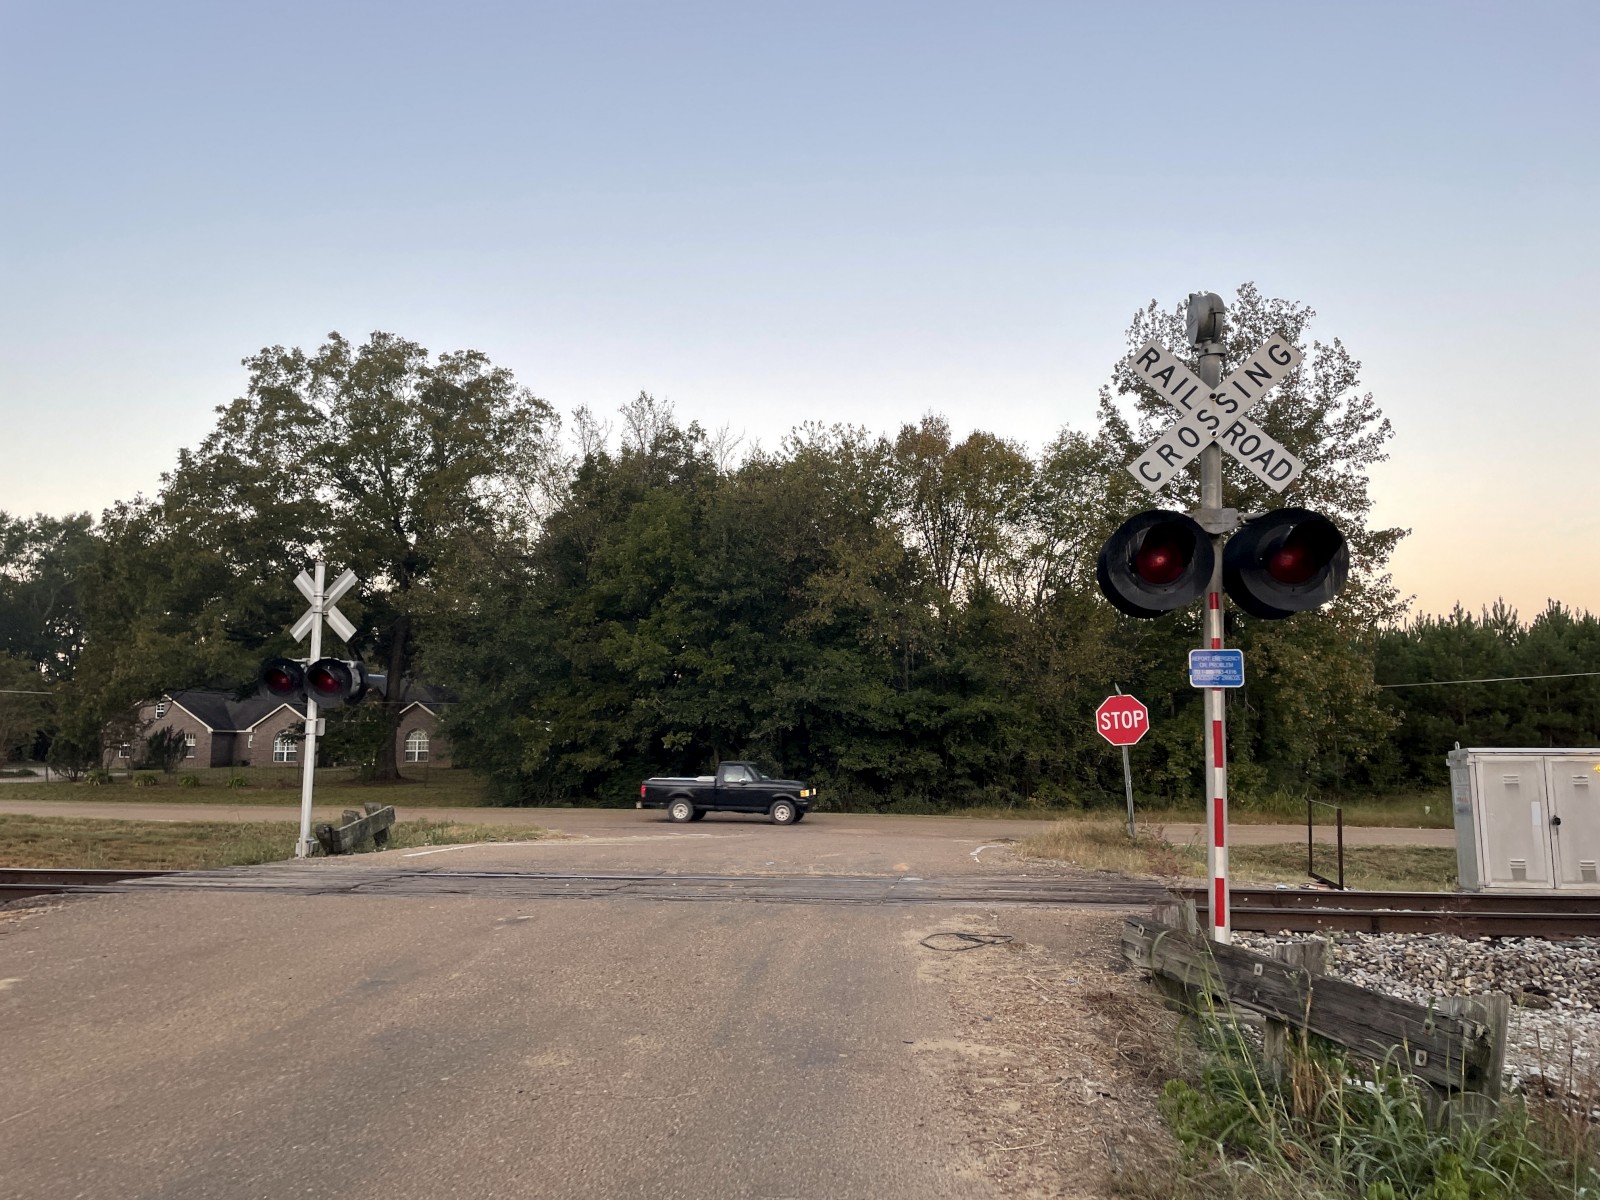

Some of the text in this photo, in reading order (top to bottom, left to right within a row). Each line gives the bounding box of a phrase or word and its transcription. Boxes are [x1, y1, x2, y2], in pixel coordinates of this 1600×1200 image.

[1136, 346, 1293, 482] RAIL ROAD
[1138, 343, 1292, 483] CROSSING
[1100, 710, 1144, 730] STOP
